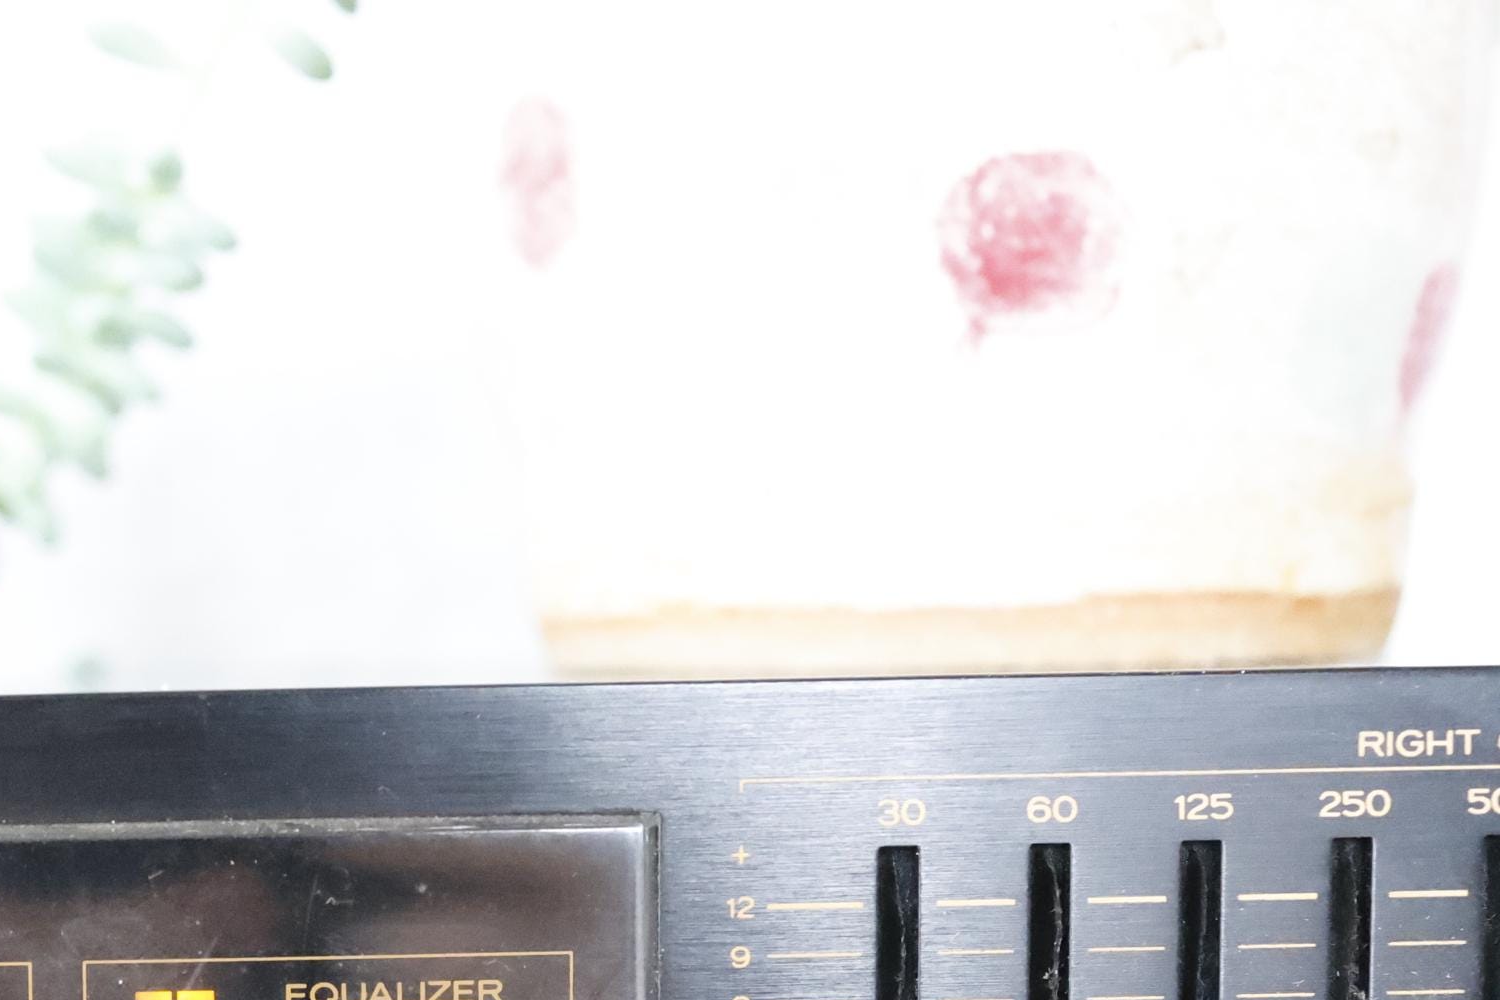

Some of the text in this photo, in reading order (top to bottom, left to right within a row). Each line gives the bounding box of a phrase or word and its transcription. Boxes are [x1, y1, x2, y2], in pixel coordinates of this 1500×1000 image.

[1358, 729, 1480, 757] RIGHT
[879, 799, 926, 827] 30
[1027, 795, 1078, 823] 60
[1175, 793, 1234, 820] 125
[1319, 790, 1391, 817] 250
[726, 896, 755, 919] 12
[730, 946, 752, 968] 9
